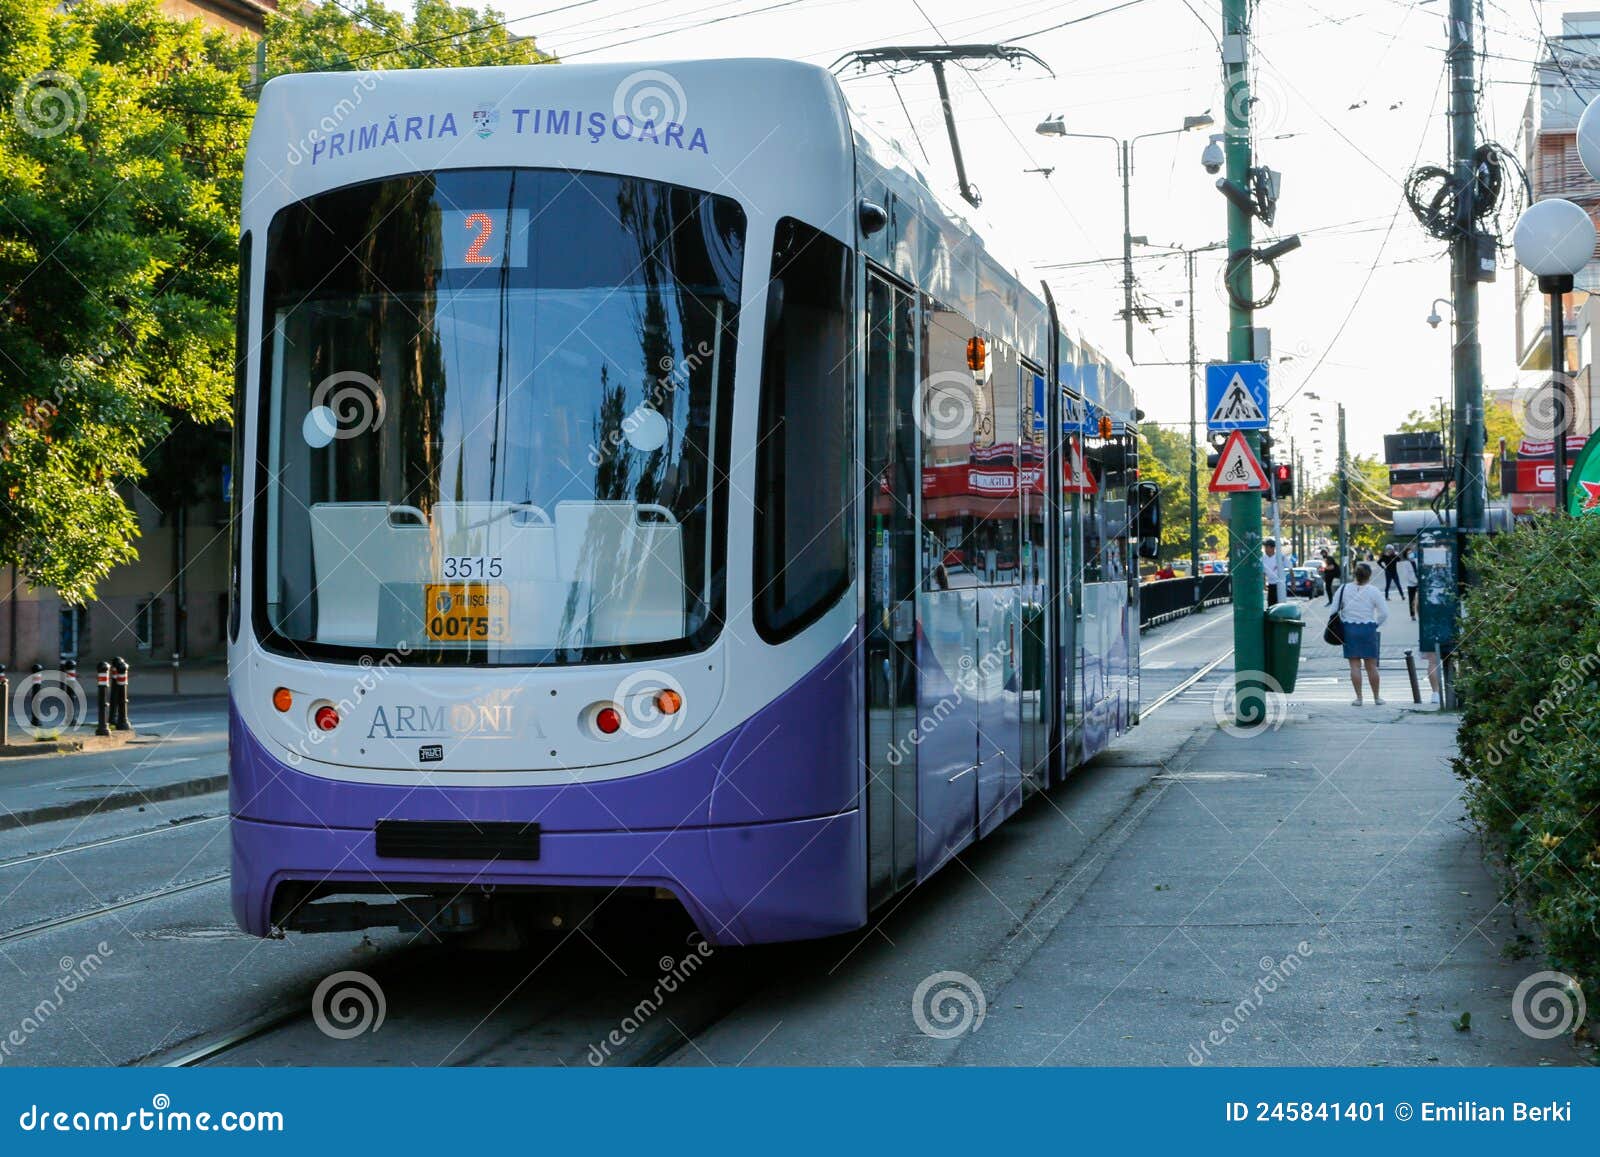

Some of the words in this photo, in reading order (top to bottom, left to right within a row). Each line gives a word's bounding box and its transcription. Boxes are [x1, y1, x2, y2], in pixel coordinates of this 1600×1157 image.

[311, 112, 458, 166] PRIMĂRIA
[464, 212, 493, 265] 2
[444, 557, 503, 578] 3515
[431, 616, 505, 637] 00755
